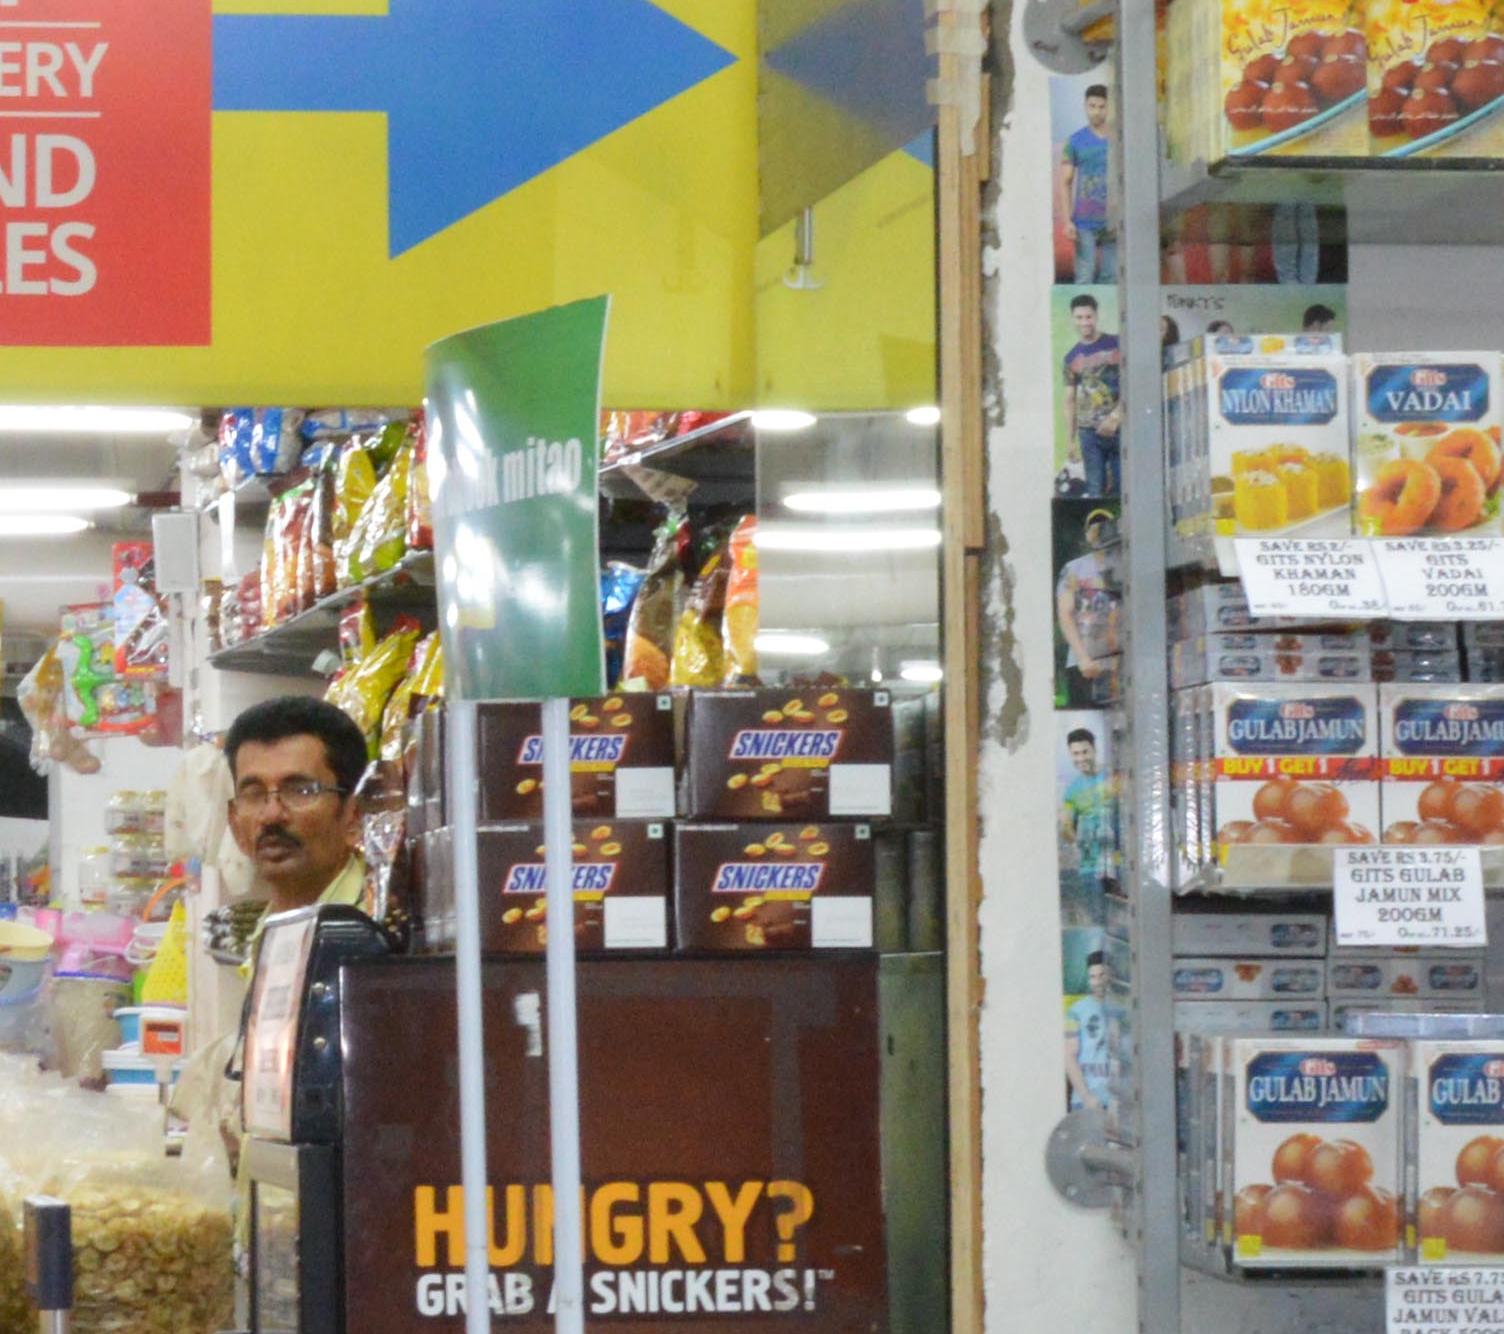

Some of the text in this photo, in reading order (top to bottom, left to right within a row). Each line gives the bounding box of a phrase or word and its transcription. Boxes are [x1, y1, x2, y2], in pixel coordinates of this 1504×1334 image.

[1221, 388, 1336, 414] NYLON KHAMAN
[1386, 391, 1472, 412] VADAI
[503, 437, 583, 501] mitao
[1256, 553, 1299, 566] GITS
[1274, 568, 1357, 581] KHAMAN
[1229, 718, 1364, 742] GULAB JAMUN
[734, 732, 839, 756] SNICKERS
[1223, 758, 1263, 775] BUY
[1280, 758, 1316, 775] GET
[717, 865, 821, 889] SNICKERS
[1350, 870, 1465, 883] GITS GULAB
[1356, 889, 1462, 903] JAMUN MIX
[591, 1269, 816, 1314] SNICKERS!
[1403, 1289, 1447, 1305] GITS
[1393, 1308, 1460, 1325] JAMUN
